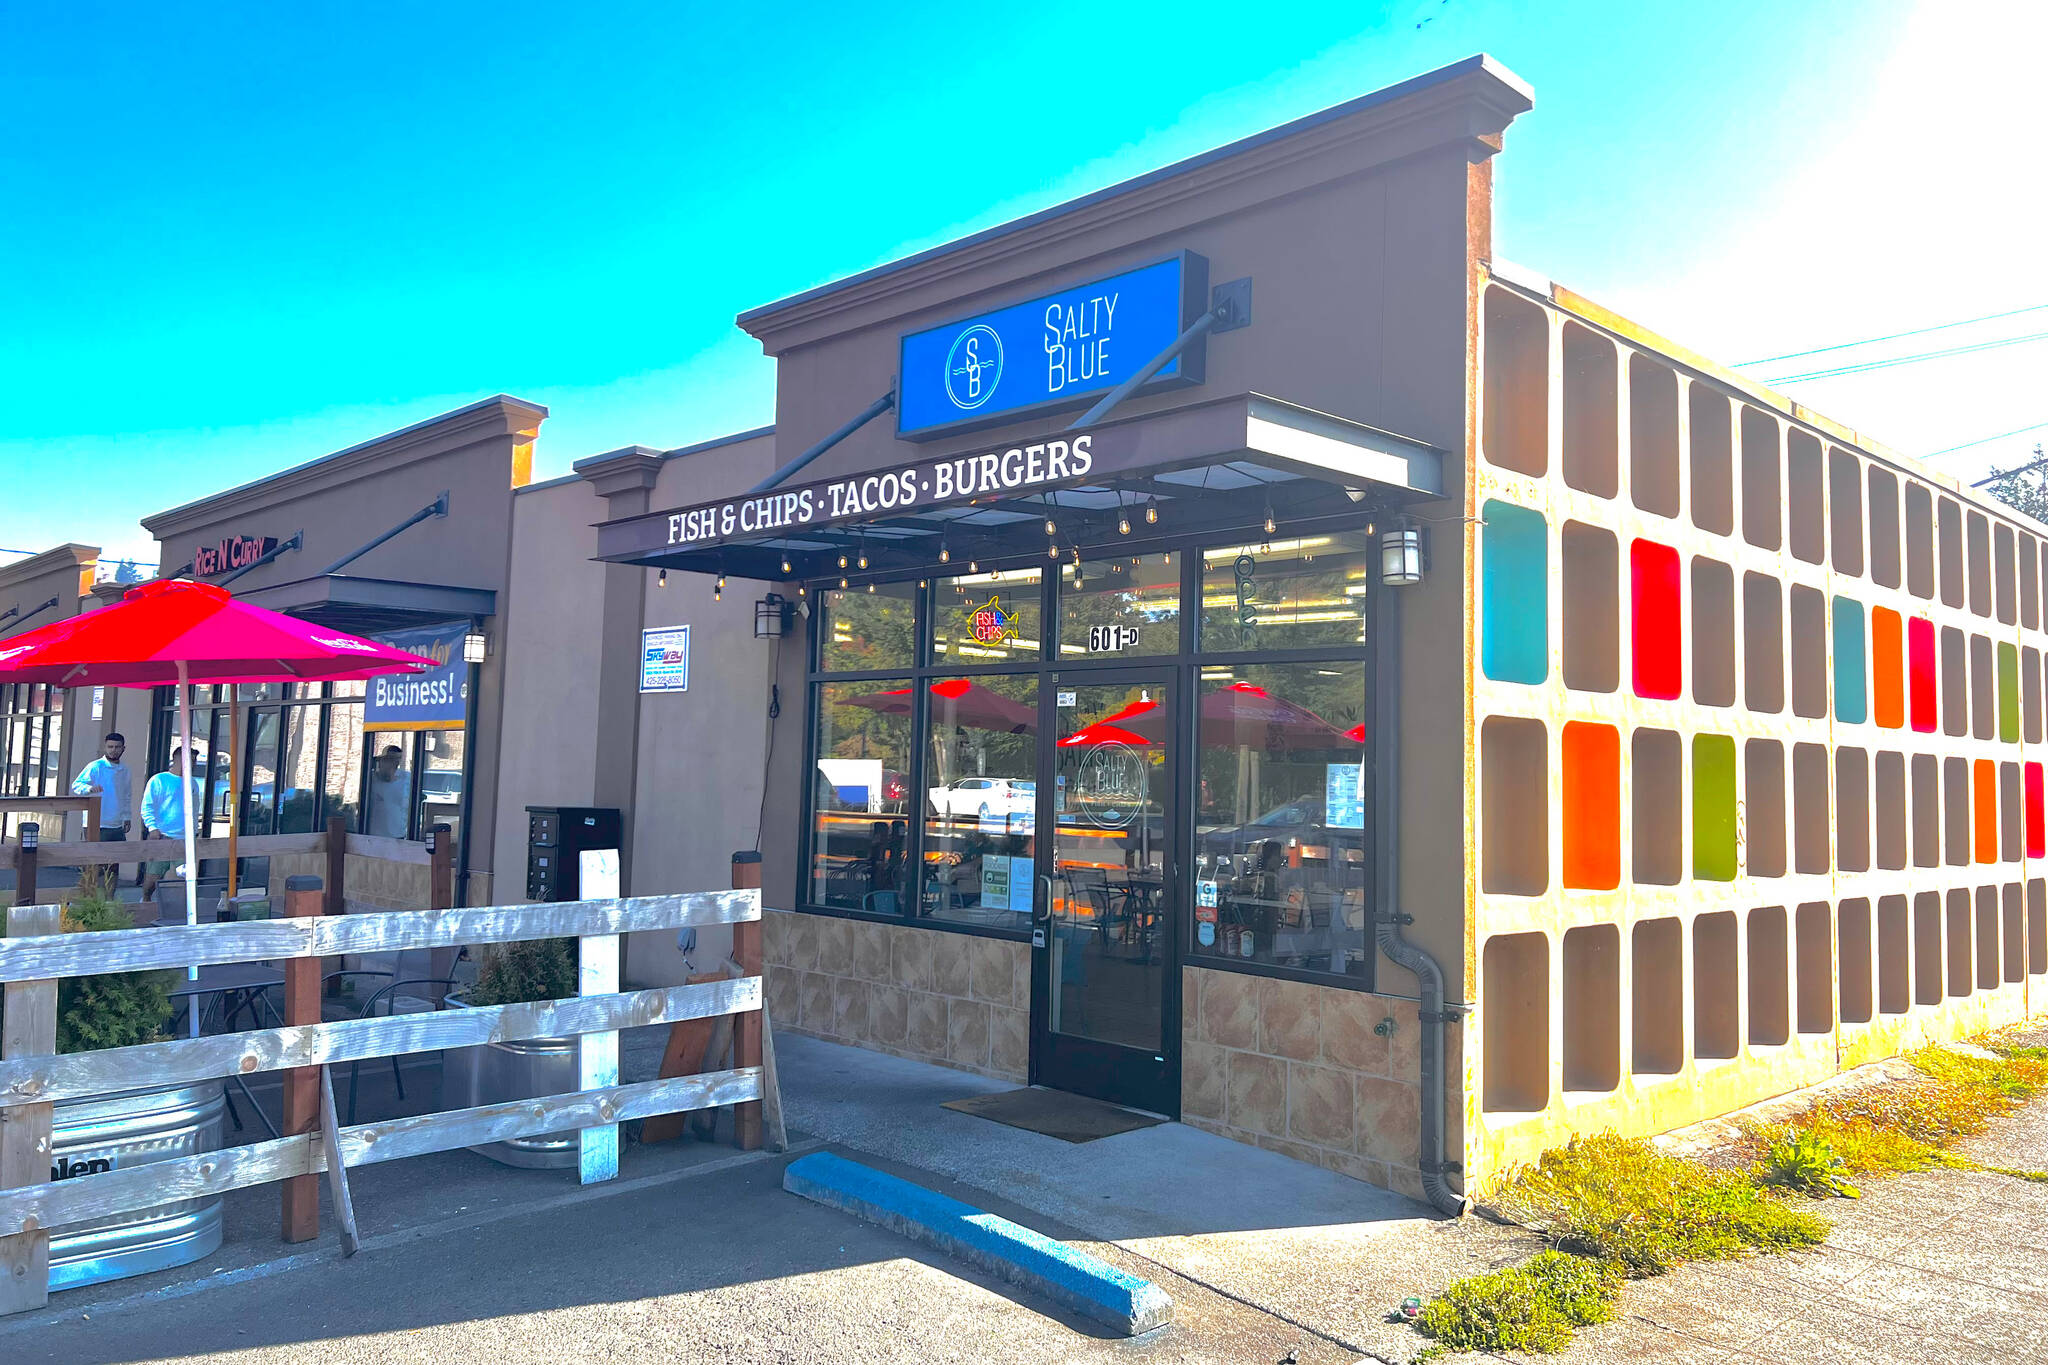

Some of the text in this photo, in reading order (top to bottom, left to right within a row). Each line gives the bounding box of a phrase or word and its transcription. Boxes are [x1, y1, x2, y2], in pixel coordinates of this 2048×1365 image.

[1045, 293, 1118, 353] SALTY
[1049, 338, 1110, 392] BLUE
[667, 435, 1093, 545] FISH & CHIPS TACOS BURGERS
[195, 535, 265, 577] RICE N CURRY
[976, 625, 1003, 641] CHIPS
[1090, 625, 1138, 652] 601-D
[376, 672, 454, 707] Business!
